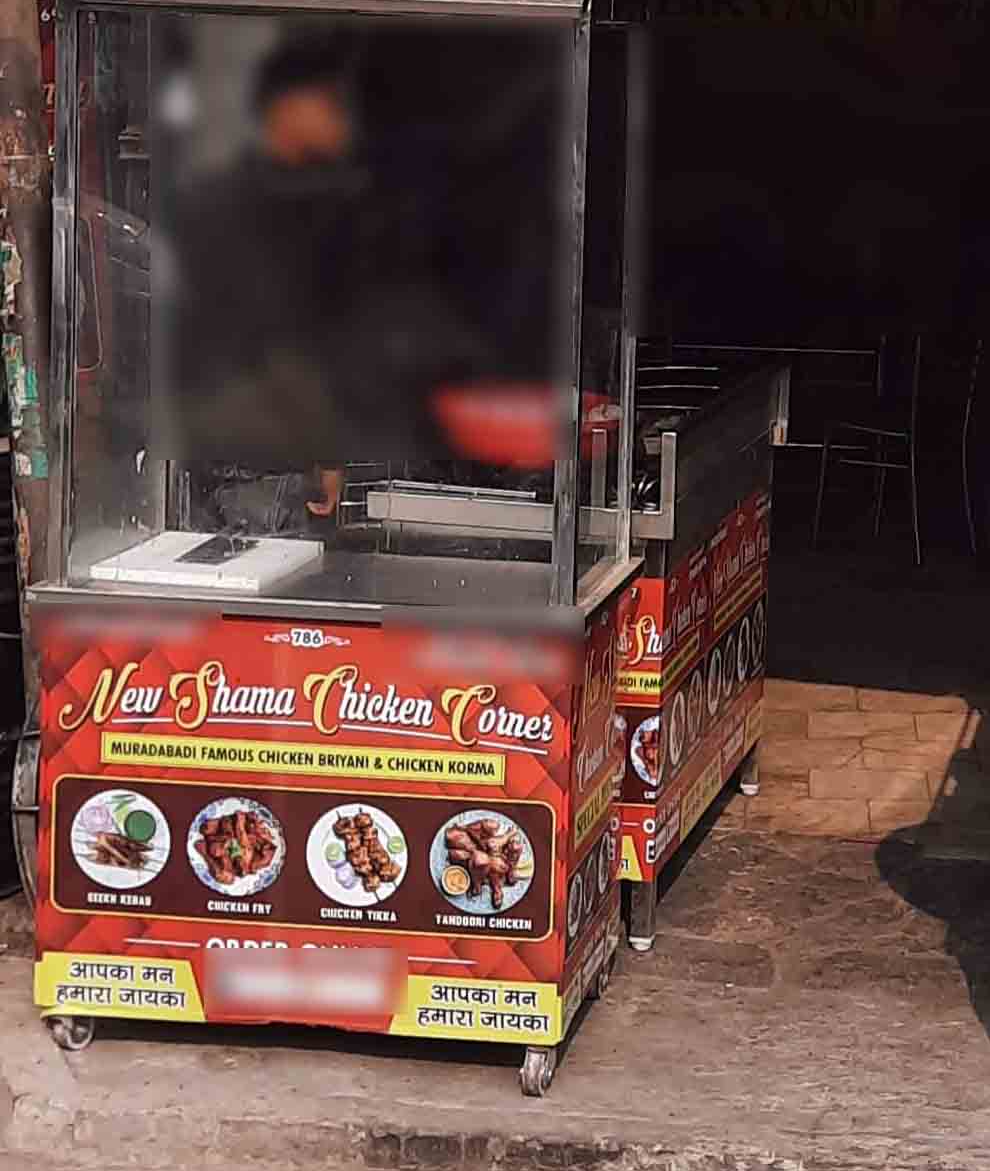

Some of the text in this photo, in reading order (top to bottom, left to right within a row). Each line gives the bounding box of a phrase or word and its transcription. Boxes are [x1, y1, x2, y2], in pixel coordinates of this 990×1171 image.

[290, 629, 323, 647] 786
[58, 660, 553, 745] New Shama Chicken Corner
[111, 742, 495, 776] MURADABADI FAMOUS CHICKEN BRIYANI & CHICKEN KORMA
[207, 900, 271, 914] CHICKEN FRY
[320, 907, 397, 922] CHICKEN TIKKA
[436, 914, 532, 930] TANDOORI CHICKEN
[69, 962, 174, 984] आपका मन
[57, 985, 185, 1008] हमारा जायका
[431, 985, 537, 1007] आपका मन
[418, 1007, 548, 1031] हमारा जायका
